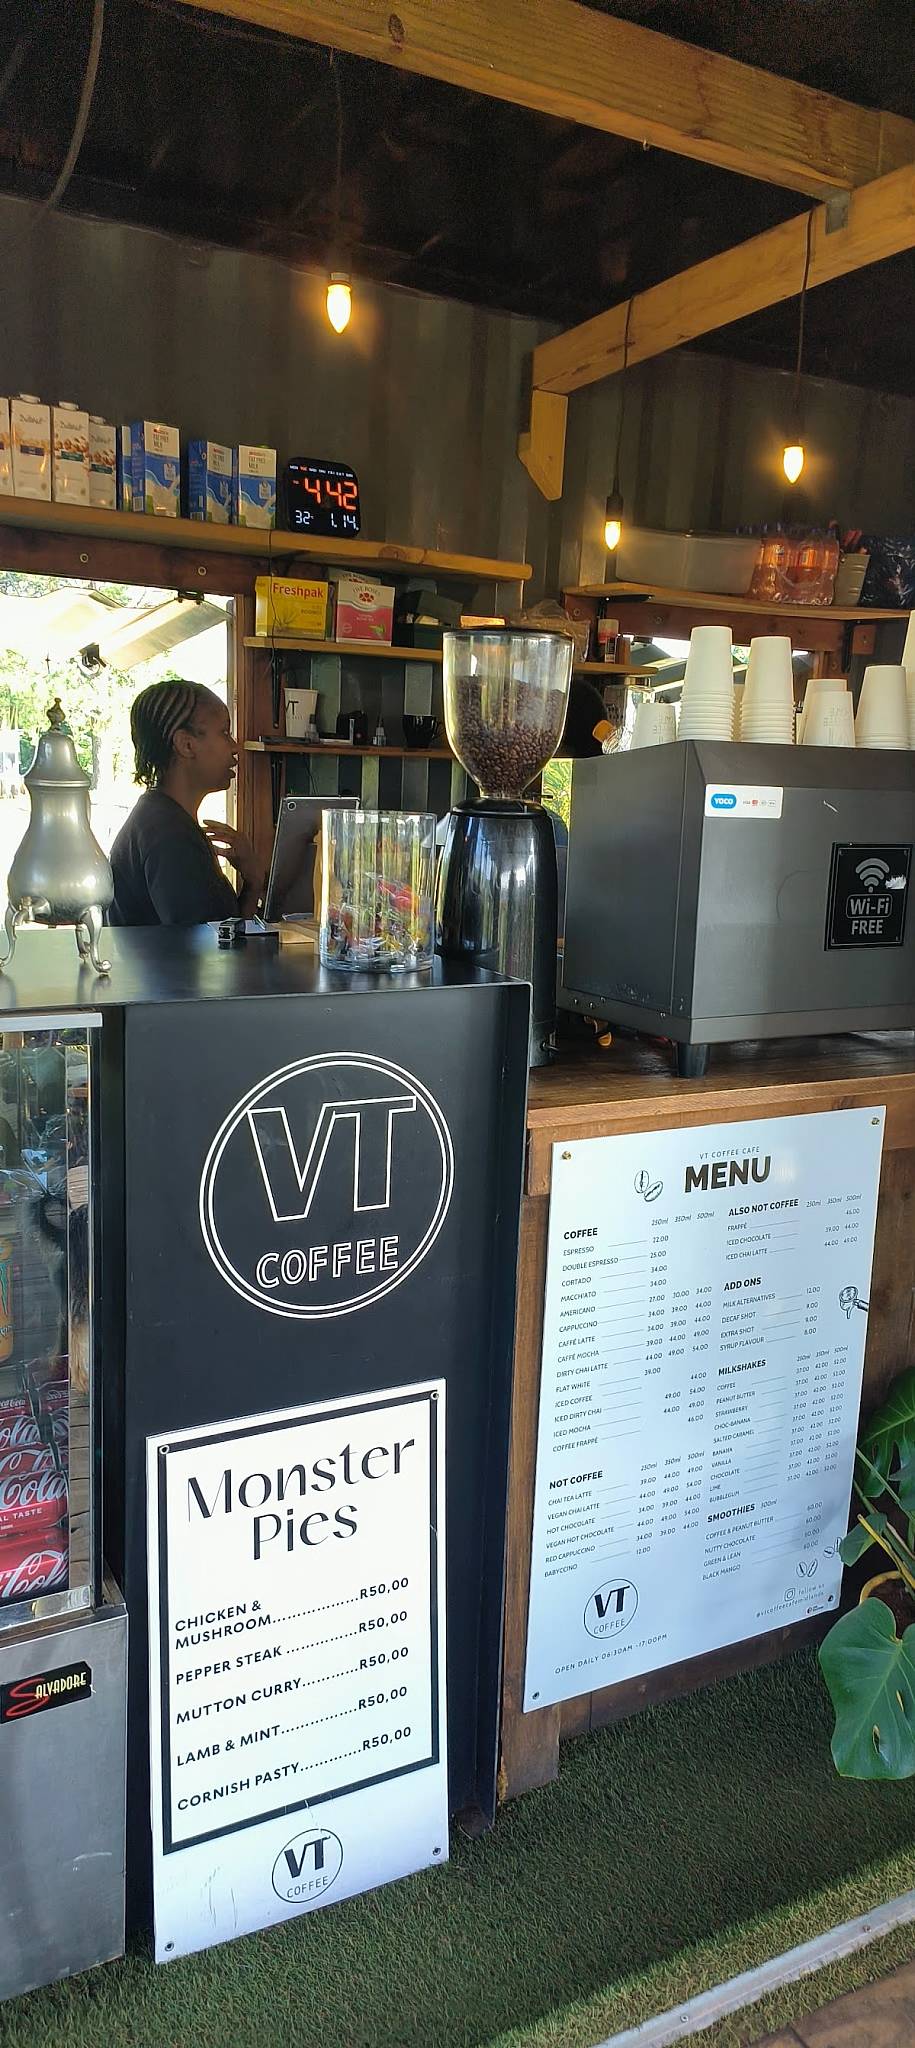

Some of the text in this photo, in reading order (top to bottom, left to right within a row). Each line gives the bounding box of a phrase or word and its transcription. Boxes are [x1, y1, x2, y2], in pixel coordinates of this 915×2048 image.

[272, 582, 324, 600] Freshpak
[713, 797, 734, 805] YOCO
[850, 897, 890, 915] Wi-Fi
[851, 919, 884, 935] FREE
[247, 1095, 417, 1222] VT
[711, 1149, 738, 1158] COFFEE
[684, 1155, 771, 1193] MENU
[729, 1198, 798, 1216] ALSO NOT COFFEE
[563, 1227, 597, 1240] COFFEE
[740, 1233, 770, 1243] CHOCOLATE
[563, 1245, 594, 1256] ESPRESSO
[752, 1248, 767, 1256] LATTE
[256, 1235, 399, 1289] COFFEE
[562, 1261, 587, 1272] DOUBLE
[589, 1256, 618, 1267] ESPRESSO
[562, 1276, 591, 1287] CORTADO
[724, 1276, 761, 1291] ADD ONS
[561, 1290, 596, 1303] MACCHIATO
[723, 1292, 775, 1308] MILK ALTERNATIVES
[560, 1305, 595, 1318] AMERICANO
[741, 1311, 755, 1319] SHOT
[559, 1320, 597, 1333] CAPPUCCINO
[720, 1326, 754, 1338] EXTRA SHOT
[558, 1338, 576, 1348] CAFFÉ
[577, 1335, 595, 1344] LATTE
[719, 1341, 738, 1351] SYRUP
[558, 1353, 575, 1363] CAFFÉ
[577, 1349, 599, 1359] MOCHA
[557, 1369, 573, 1378] DIRTY
[575, 1366, 589, 1374] CHAI
[590, 1362, 608, 1371] LATTE
[718, 1358, 765, 1376] MILKSHAKES
[556, 1384, 570, 1393] FLAT
[571, 1380, 590, 1390] WHITE
[555, 1399, 568, 1408] ICED
[570, 1395, 592, 1404] COFFEE
[554, 1407, 601, 1423] ICED DIRTY CHAI
[553, 1429, 567, 1438] ICED
[568, 1424, 590, 1434] MOCHA
[552, 1442, 575, 1453] COFFEE
[188, 1438, 415, 1522] Monster
[549, 1469, 602, 1489] NOT COFFEE
[548, 1490, 591, 1506] CHAI TEA LATTE
[13, 1507, 42, 1519] TASTE
[547, 1510, 566, 1521] VEGAN
[568, 1507, 581, 1515] CHAI
[582, 1502, 599, 1512] LATTE
[707, 1503, 754, 1523] SMOOTHIES
[253, 1503, 358, 1560] Pies
[547, 1517, 594, 1535] HOT CHOCOLATE
[546, 1526, 613, 1549] VEGAN HOT CHOCOLATE
[545, 1544, 595, 1563] RED CAPPUCCINO
[593, 1585, 629, 1619] VT
[175, 1577, 409, 1650] MUSHROOM R50,00
[175, 1599, 261, 1632] CHICKEN &
[594, 1618, 624, 1634] COFFEE
[176, 1610, 407, 1685] PEPPER STEAK R50,00
[555, 1662, 574, 1674] OPEN
[578, 1654, 598, 1667] DAILY
[176, 1646, 409, 1724] MUTTON CURRY R50,00
[6, 1671, 87, 1717] SALVADORE
[177, 1686, 407, 1766] LAMB & MINT R50,00
[178, 1726, 411, 1811] CORNISH PASTY R50,00
[284, 1835, 330, 1881] VT
[287, 1875, 328, 1898] COFFEE
